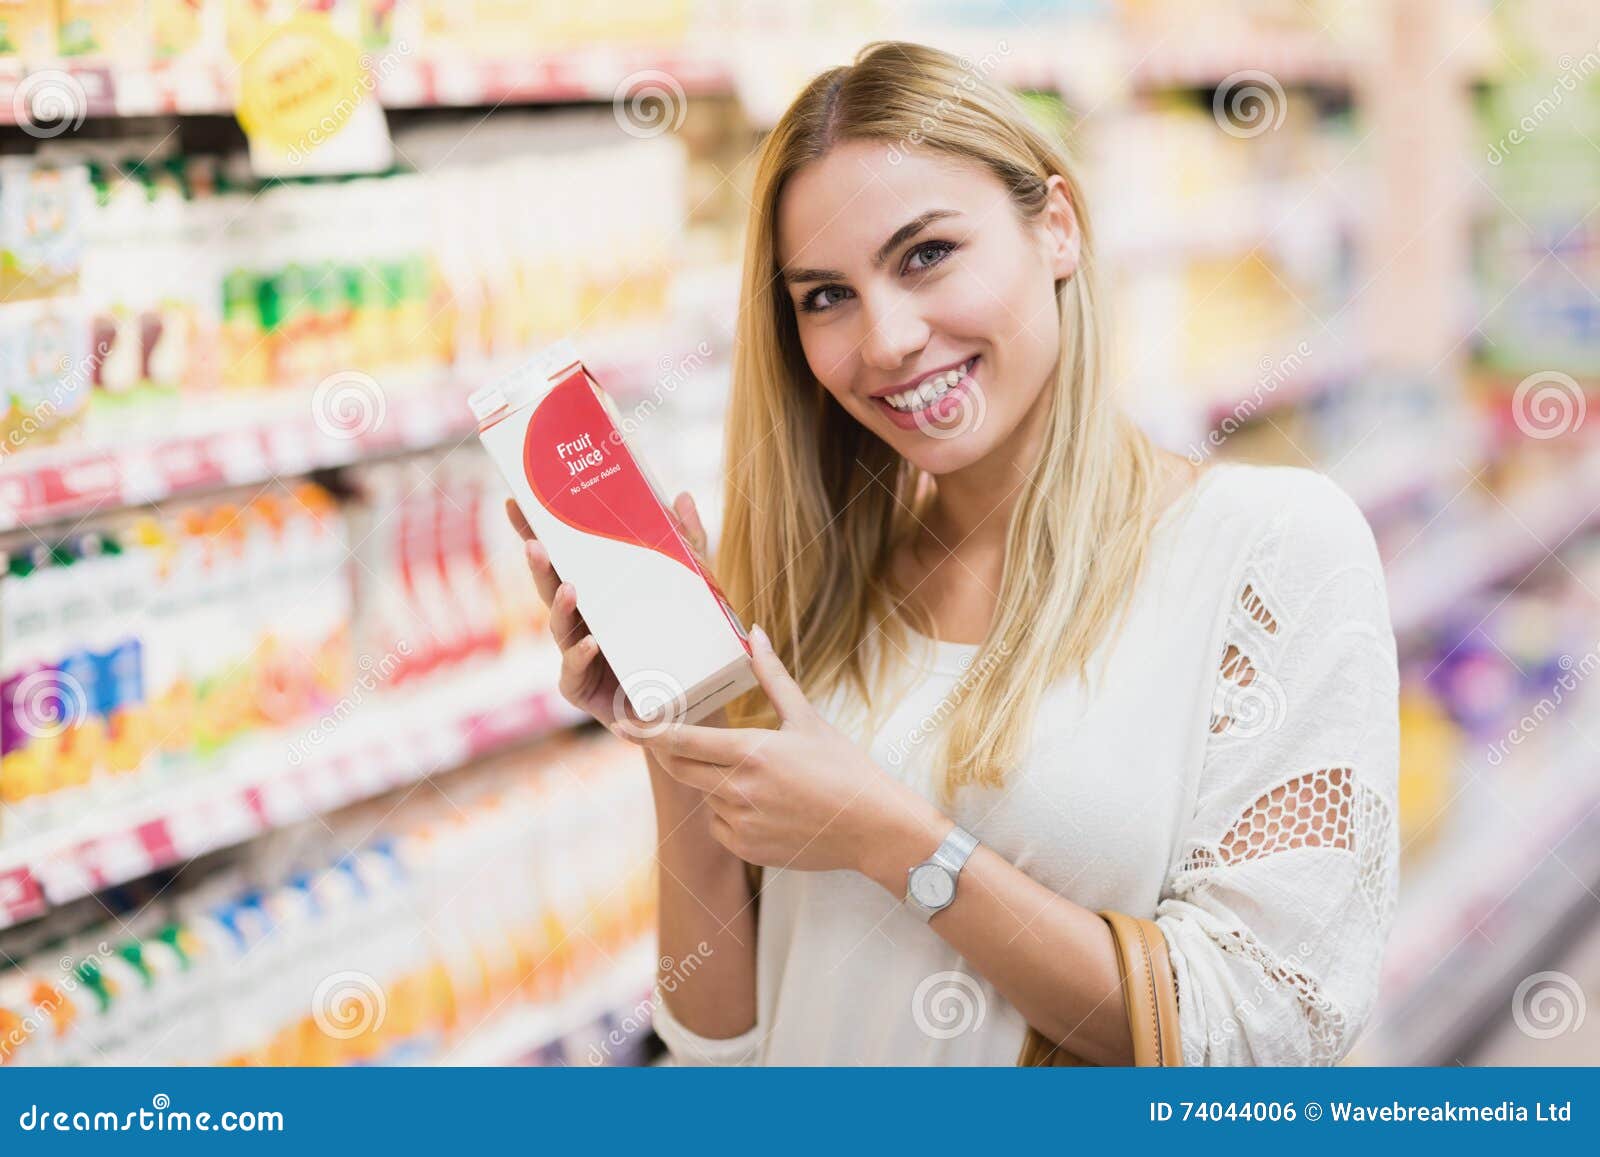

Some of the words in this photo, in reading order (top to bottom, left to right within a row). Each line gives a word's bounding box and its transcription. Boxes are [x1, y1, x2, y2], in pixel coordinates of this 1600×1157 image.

[556, 432, 593, 459] Fruit
[567, 449, 604, 476] Juice
[570, 486, 581, 495] No
[600, 463, 621, 480] Added
